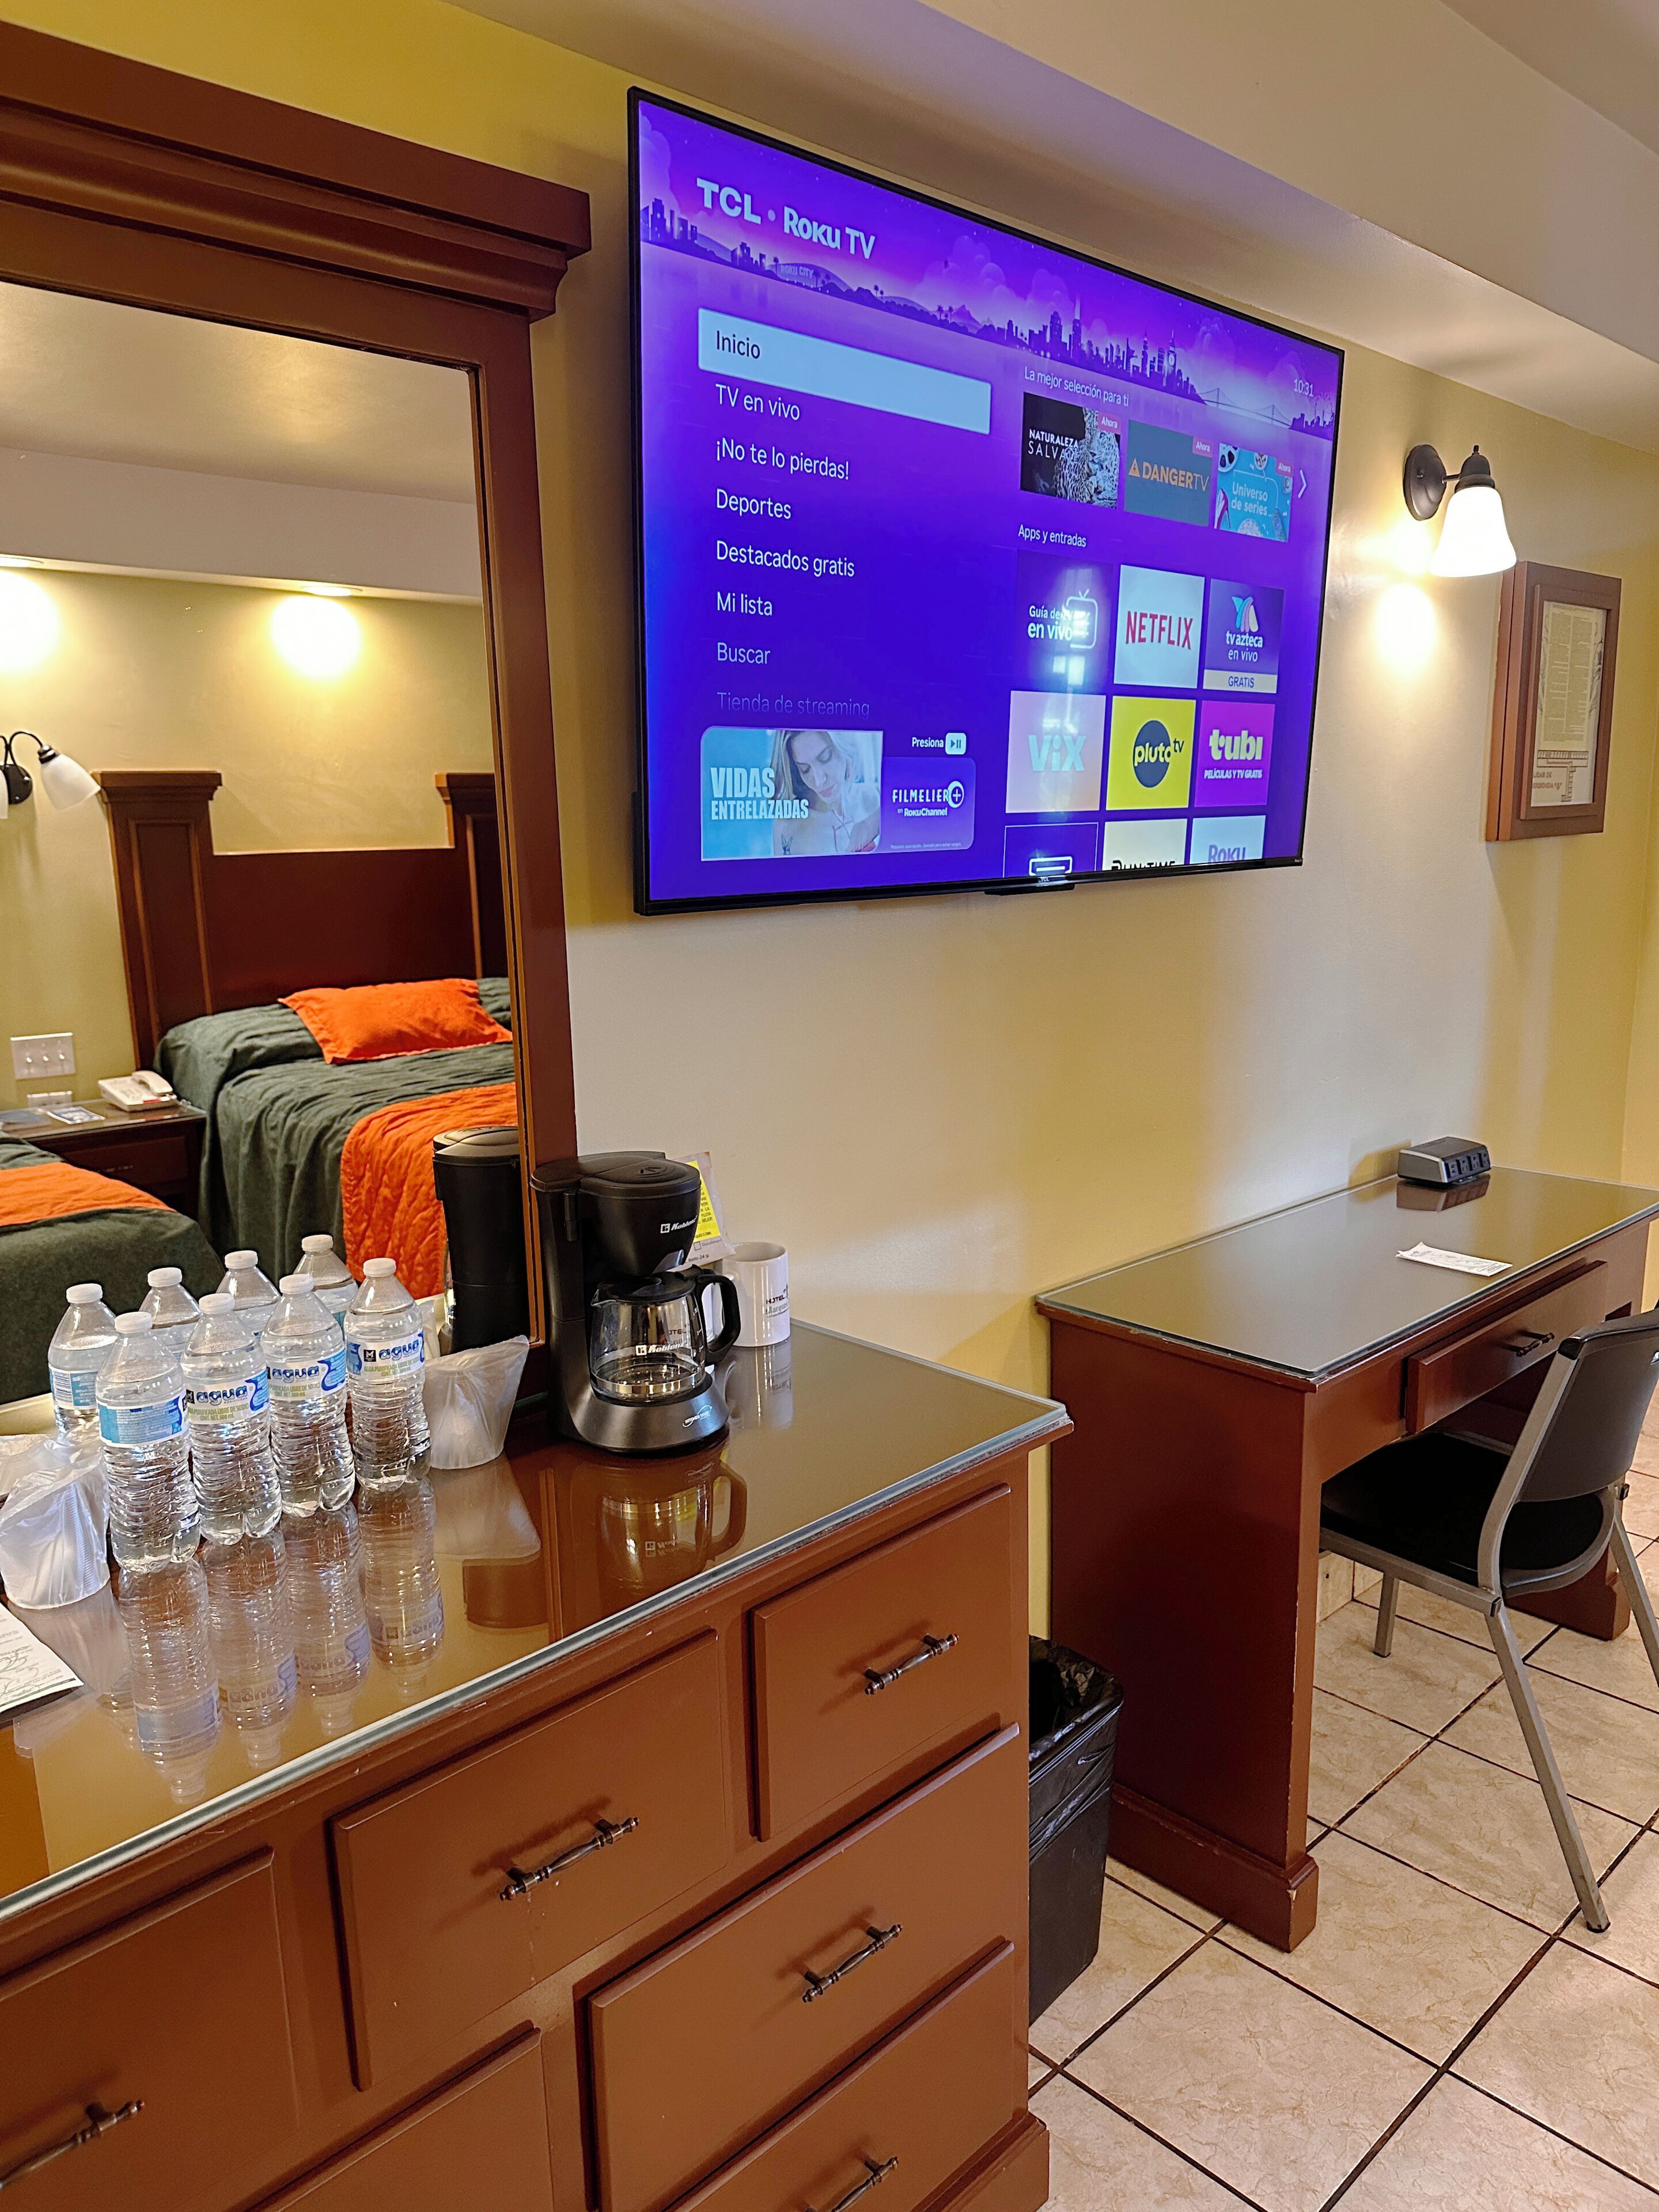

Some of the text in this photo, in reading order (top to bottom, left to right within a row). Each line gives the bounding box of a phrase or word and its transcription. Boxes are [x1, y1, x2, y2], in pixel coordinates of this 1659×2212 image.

[697, 178, 876, 259] TCL Roku TV
[716, 329, 761, 359] Inicio
[1024, 366, 1129, 407] La mejor selección para ti
[1293, 378, 1315, 397] 10:31
[715, 383, 801, 421] TV en vivo
[1101, 416, 1118, 429] Ahora
[1029, 429, 1079, 449] NATURALEZA
[1196, 441, 1211, 452] Ahora
[717, 437, 850, 480] ¡No te lo pierdas!
[1278, 463, 1291, 473] Ahora
[1233, 482, 1268, 502] Universo
[717, 488, 792, 519] Deportes
[1231, 497, 1268, 517] de series
[1018, 524, 1086, 547] Apps y entradas
[717, 540, 855, 578] Destacados gratis
[717, 591, 773, 616] Mi lista
[1029, 605, 1048, 619] Guía
[1050, 607, 1060, 620] de
[1028, 620, 1073, 641] en vivo
[1126, 611, 1194, 650] NETFLIX
[717, 642, 771, 666] Buscar
[1228, 649, 1259, 662] en vivo
[1228, 676, 1255, 689] GRATIS
[717, 692, 870, 719] Tienda de streaming
[912, 737, 944, 748] Presiona
[1134, 738, 1185, 767] pluto tv
[1209, 729, 1263, 760] tubi
[710, 767, 775, 798] VIDAS
[1204, 768, 1263, 779] PELÍCULAS Y TV GRATIS
[711, 800, 809, 820] ENTRELAZADAS
[766, 1295, 785, 1305] HOTEL
[379, 1339, 419, 1361] agua
[272, 1365, 320, 1383] agua
[196, 1385, 248, 1406] agua
[217, 1406, 230, 1415] LIBRE
[236, 1403, 249, 1411] SODIO
